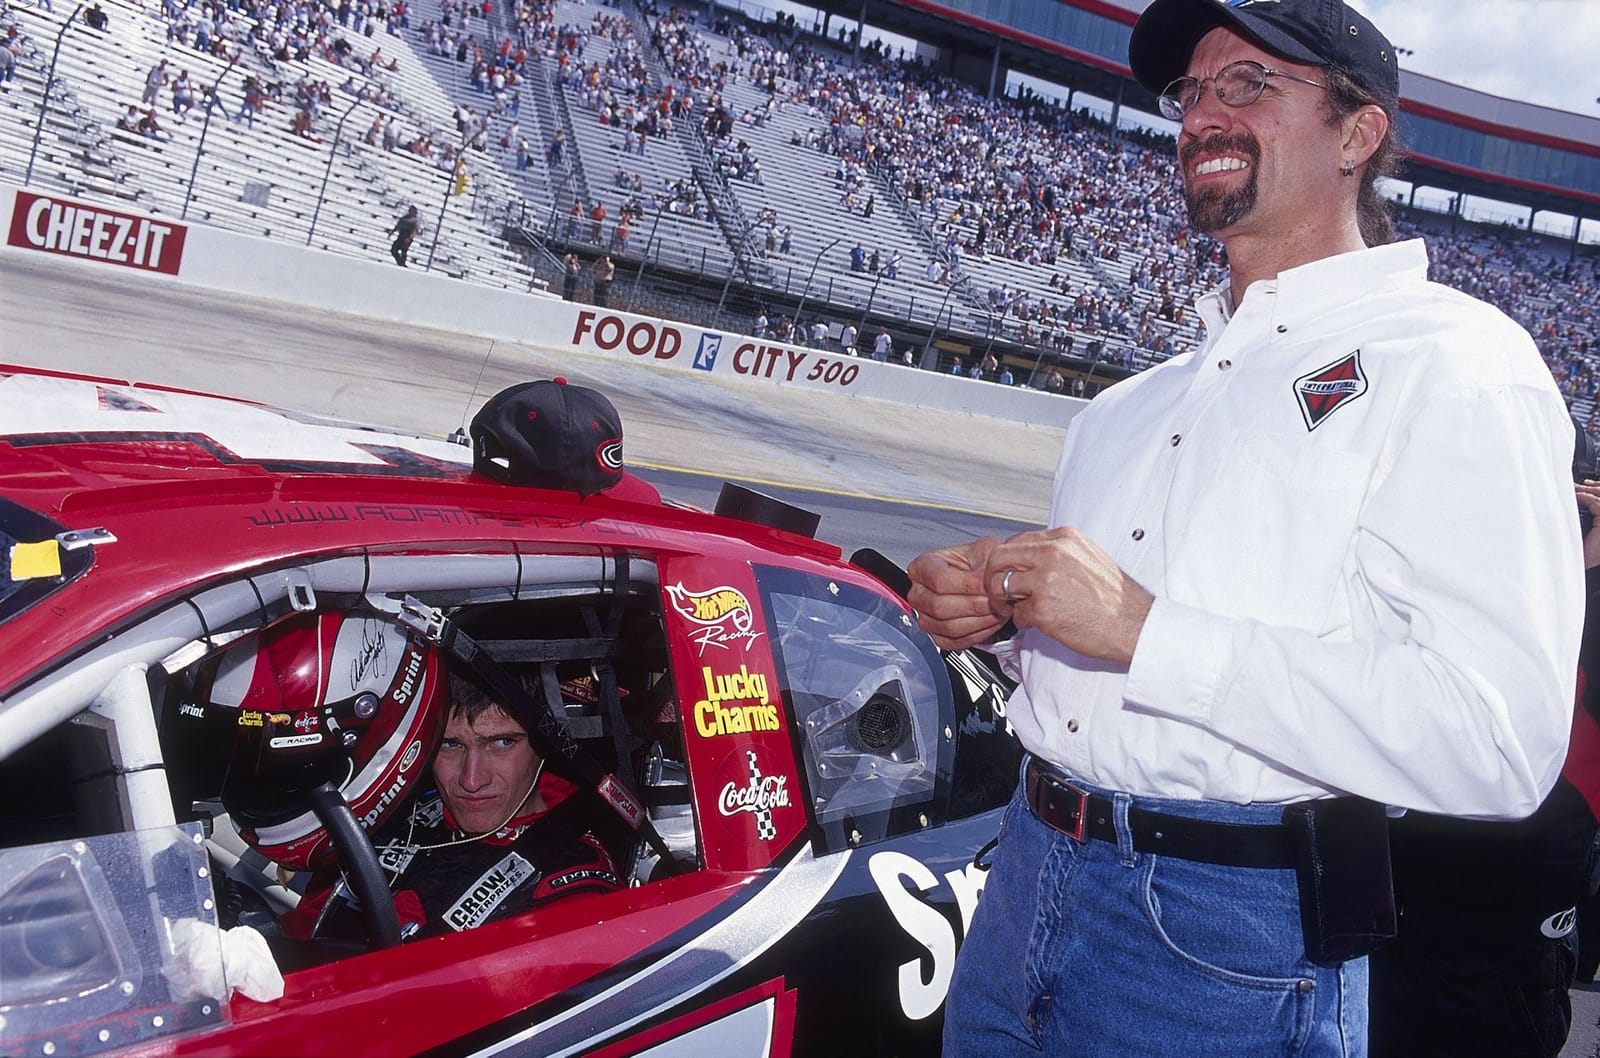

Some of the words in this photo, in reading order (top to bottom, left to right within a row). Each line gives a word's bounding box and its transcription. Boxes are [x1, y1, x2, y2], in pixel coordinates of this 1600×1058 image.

[26, 198, 172, 268] CHEEZ-IT
[572, 311, 682, 359] FOOD
[732, 343, 807, 381] CITY
[806, 358, 860, 386] 500
[687, 625, 765, 657] Racing
[392, 651, 423, 705] Sprint
[703, 664, 769, 704] Lucky
[238, 716, 264, 727] Charms
[242, 709, 262, 721] Lucky
[694, 699, 780, 738] Charms
[287, 735, 320, 744] RACING
[605, 782, 638, 818] SIMPSON
[551, 869, 618, 889] sparco
[449, 868, 508, 928] CROW
